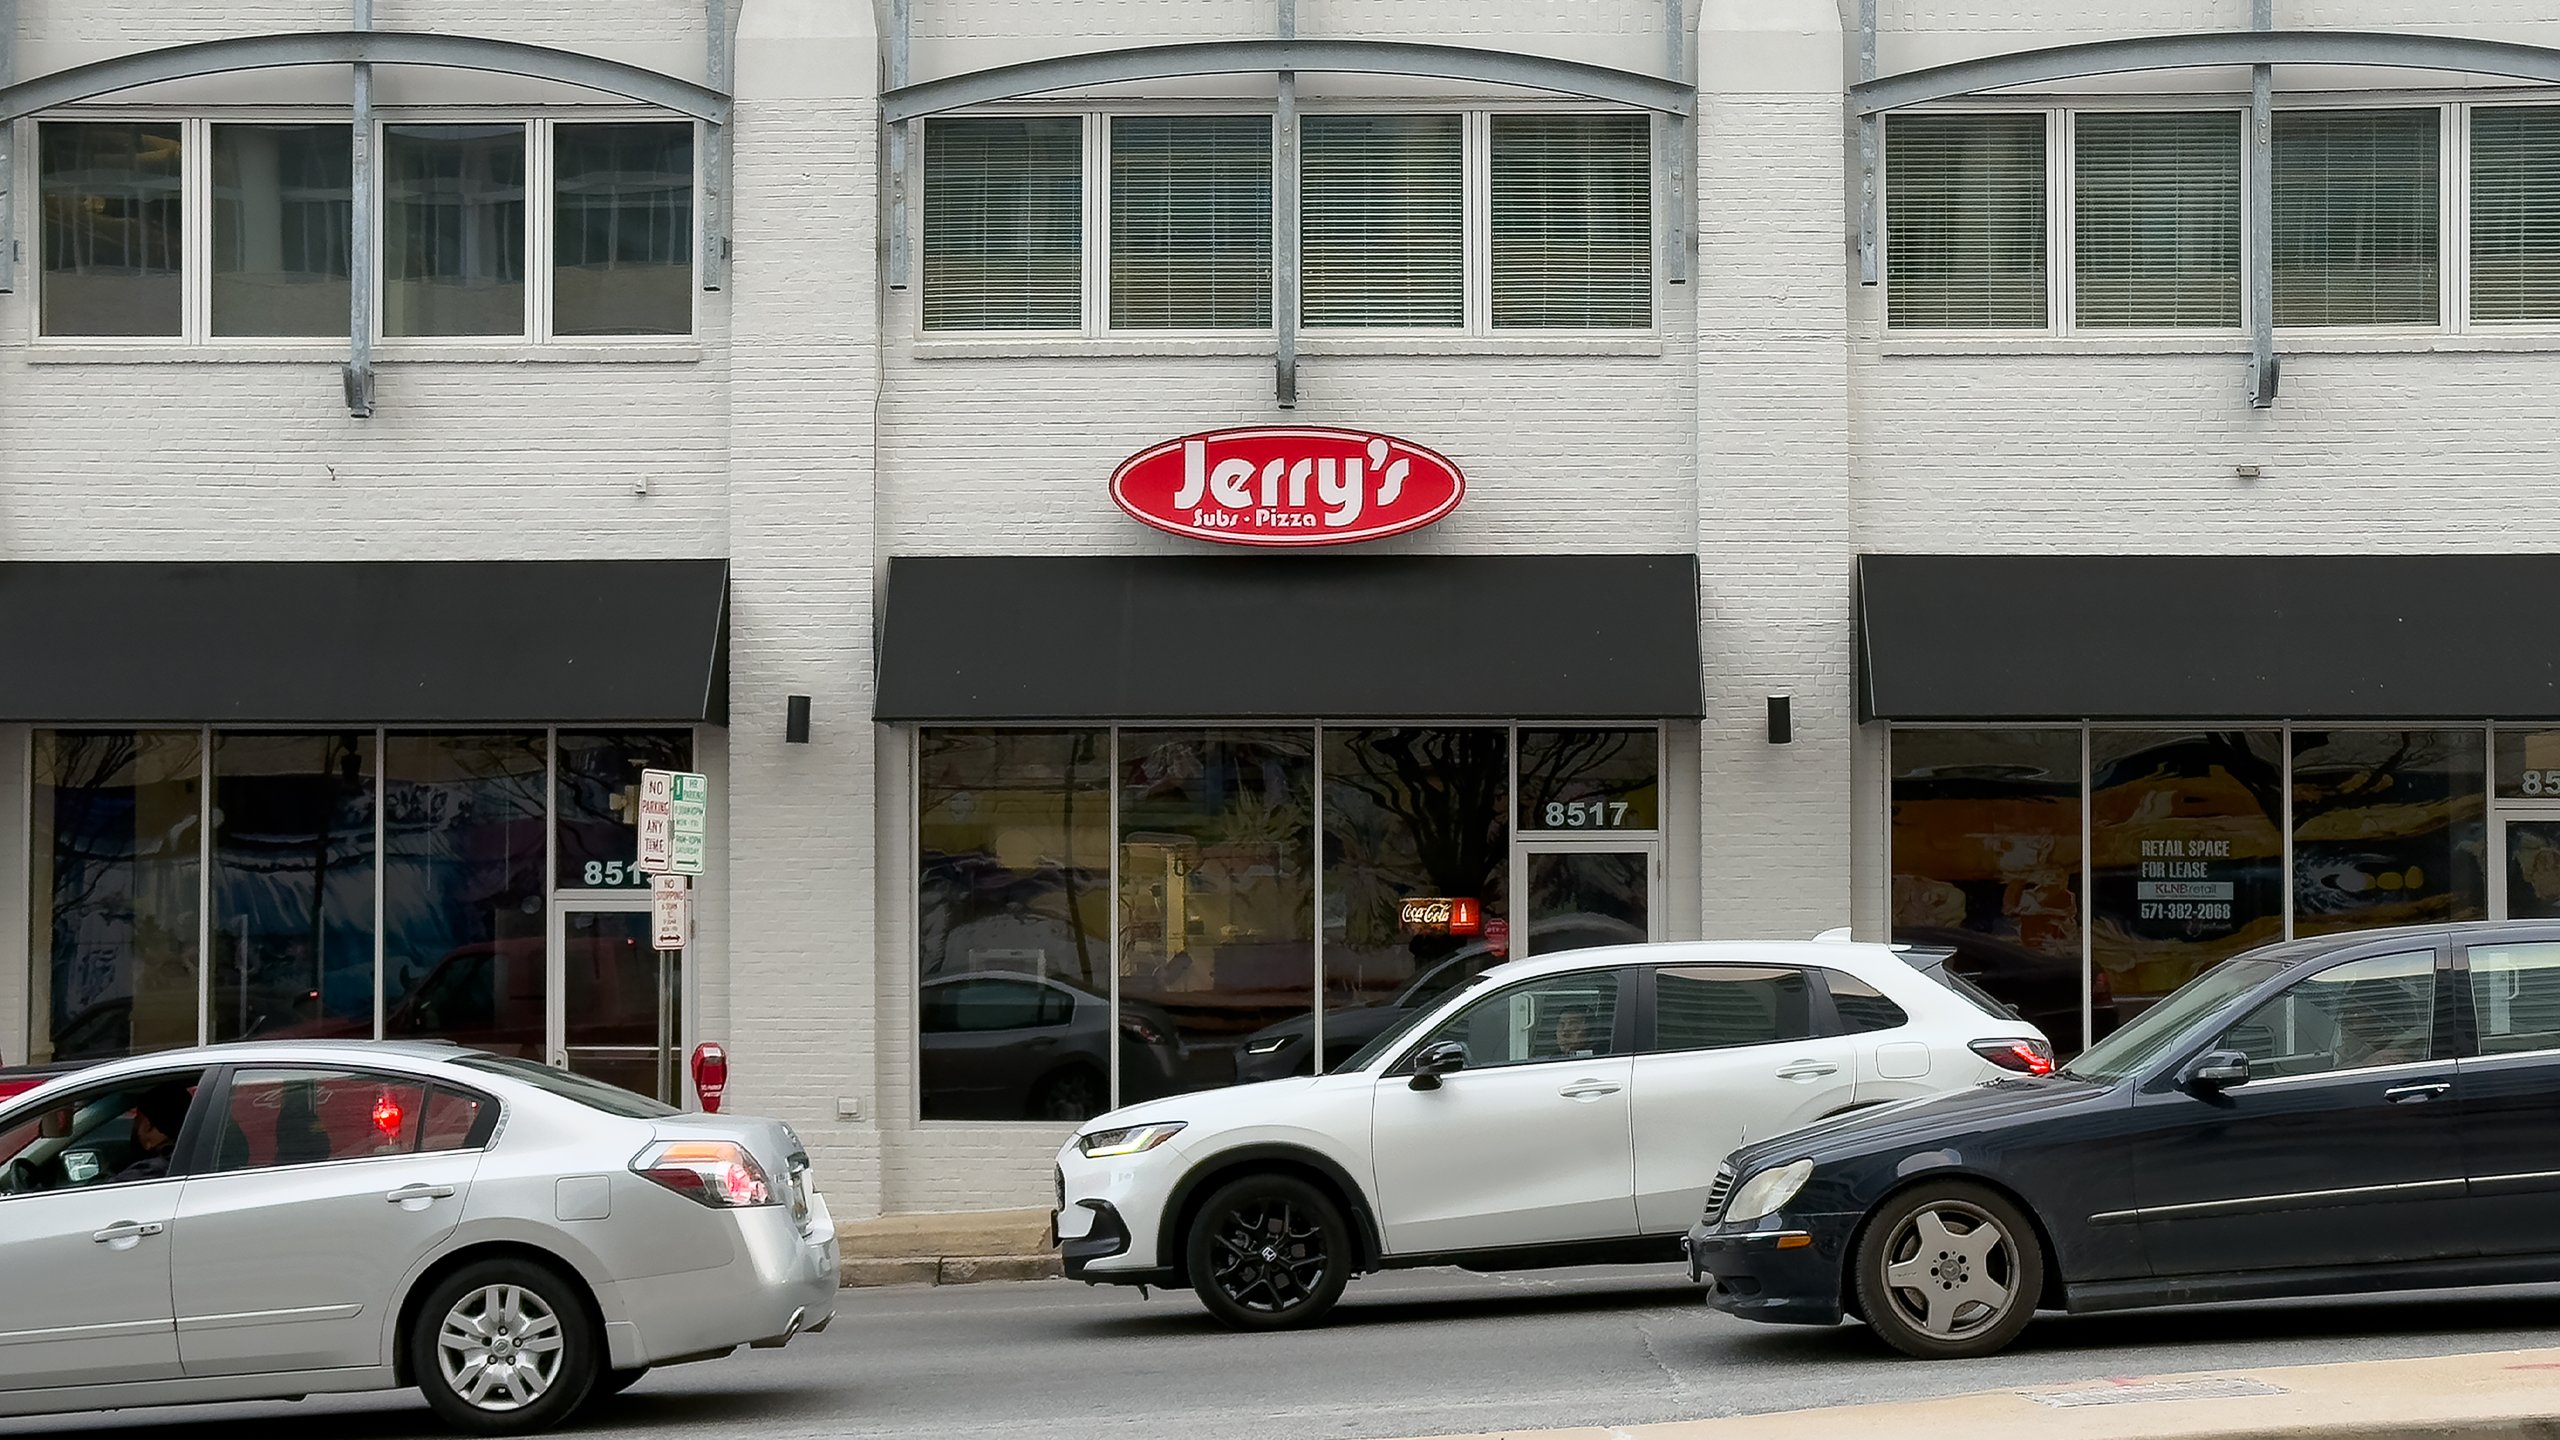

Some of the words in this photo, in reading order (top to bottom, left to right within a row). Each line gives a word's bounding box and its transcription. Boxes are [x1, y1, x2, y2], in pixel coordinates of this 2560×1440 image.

[1174, 437, 1410, 527] Jerry's
[1192, 508, 1239, 527] Subs
[1255, 508, 1317, 527] Pizza
[649, 781, 664, 795] NO
[642, 800, 669, 815] PARKING
[1545, 802, 1628, 826] 8517
[646, 820, 663, 833] ANY
[645, 838, 665, 853] TIME
[2142, 840, 2185, 857] RETAIL
[2188, 840, 2230, 857] SPACE
[584, 861, 652, 885] 851
[2142, 862, 2165, 878] FOR
[2169, 862, 2208, 878] LEASE
[664, 878, 674, 889] NO
